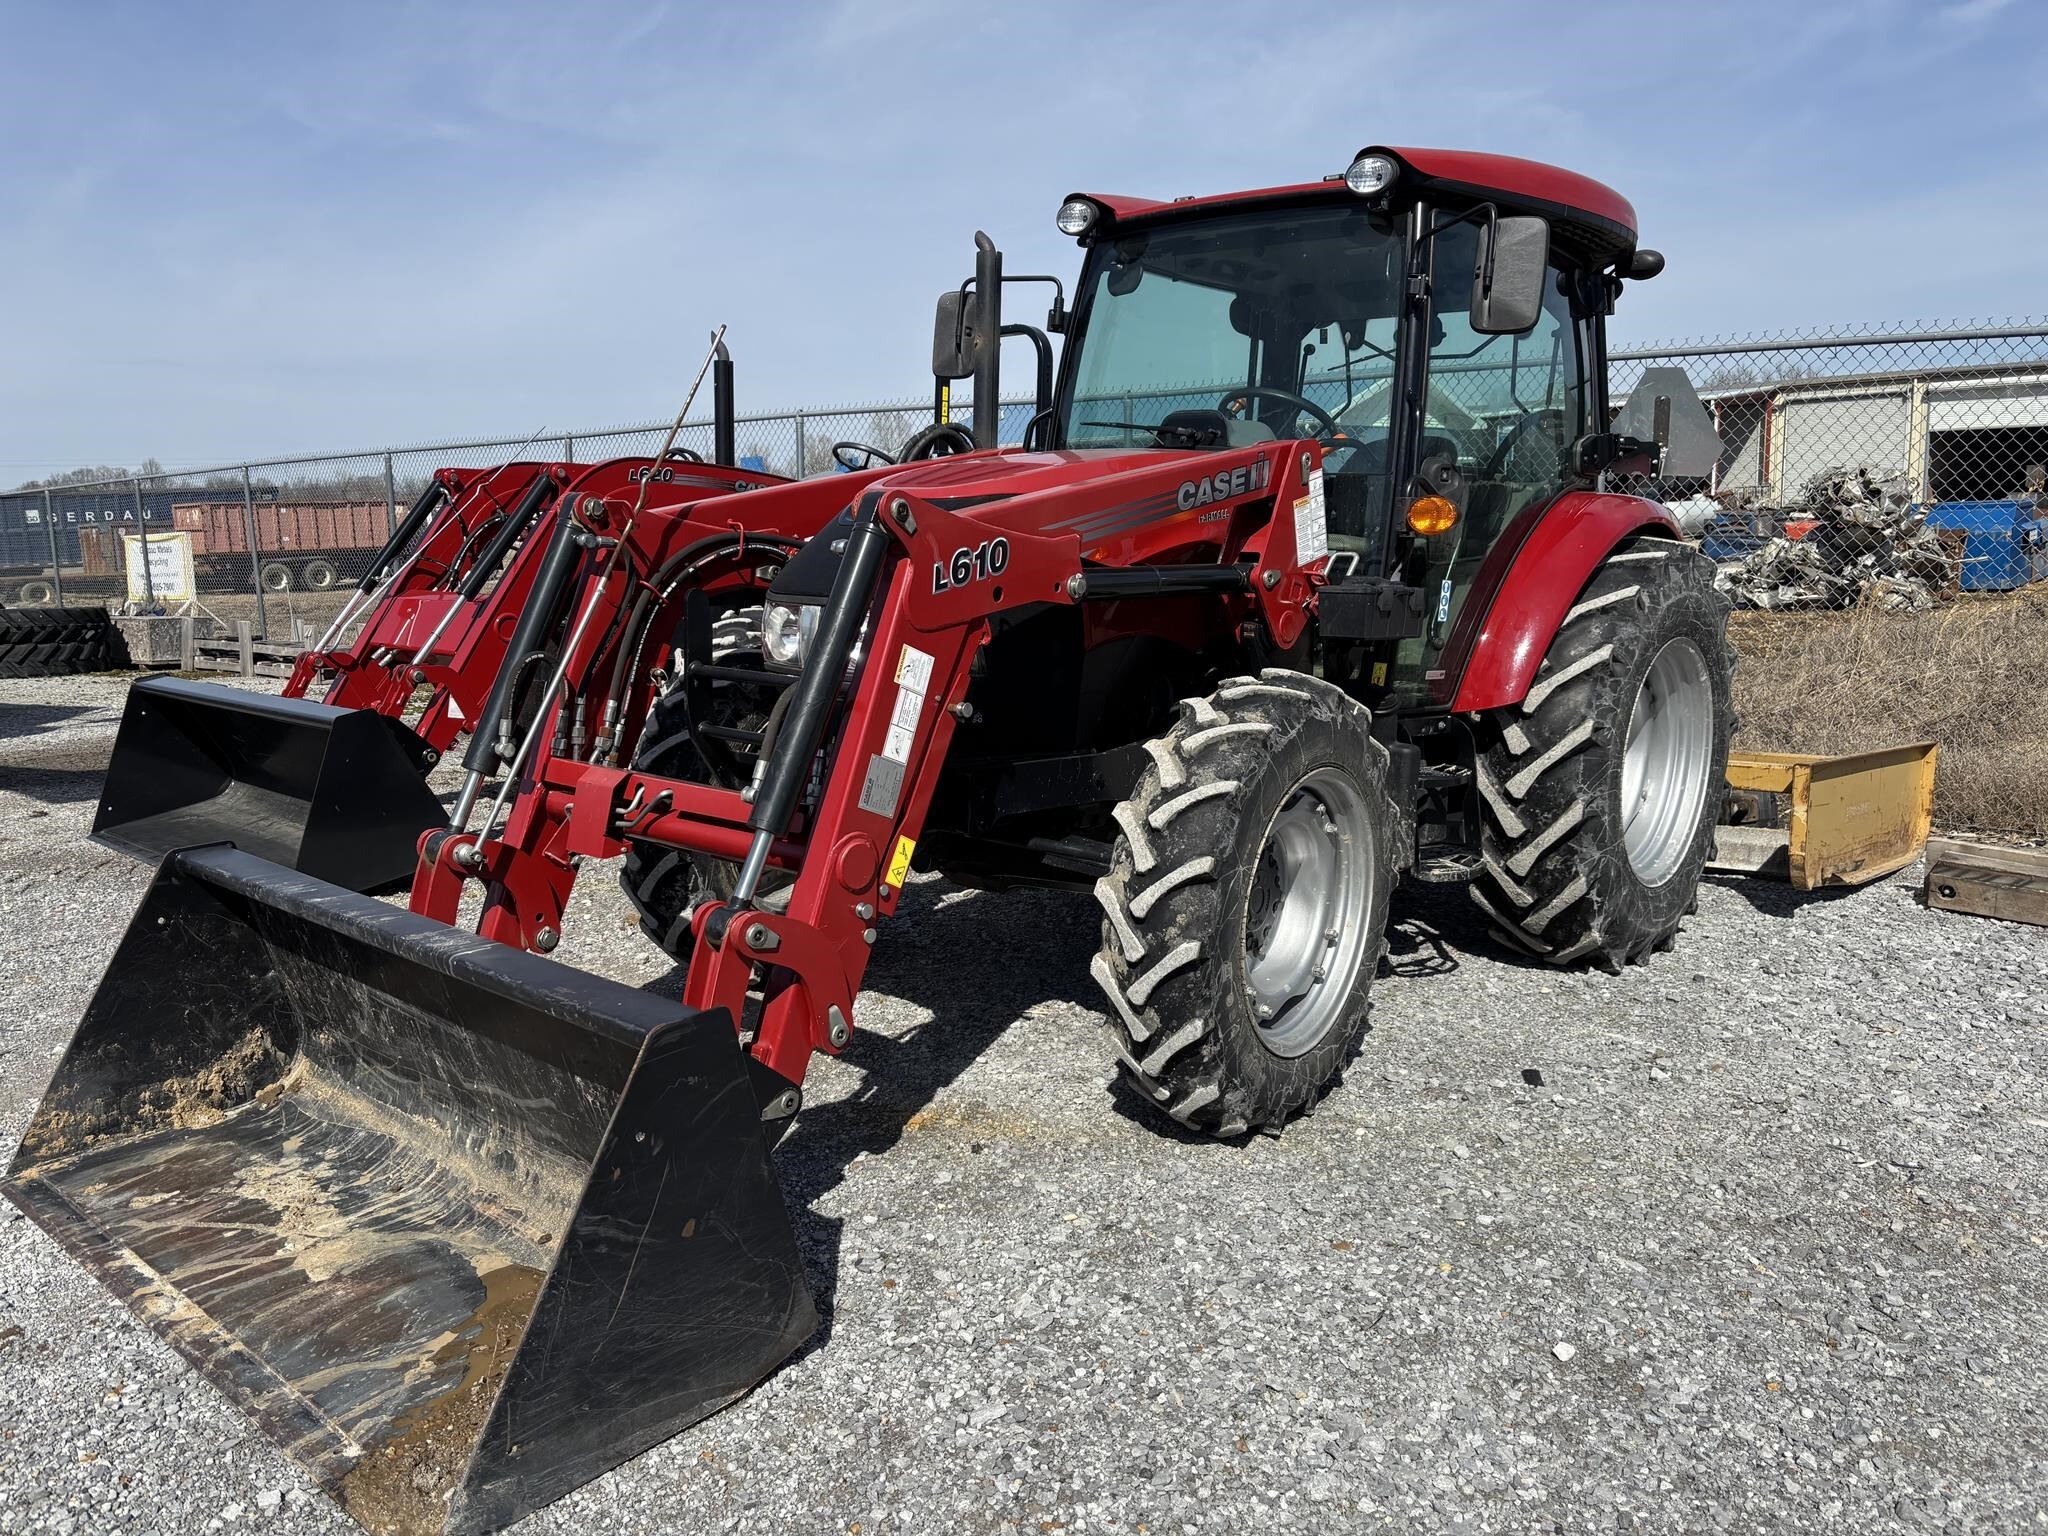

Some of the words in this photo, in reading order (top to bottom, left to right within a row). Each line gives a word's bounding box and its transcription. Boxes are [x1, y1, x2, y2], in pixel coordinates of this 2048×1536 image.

[735, 480, 768, 493] CA
[1177, 467, 1247, 511] CASE
[932, 536, 1009, 595] L610
